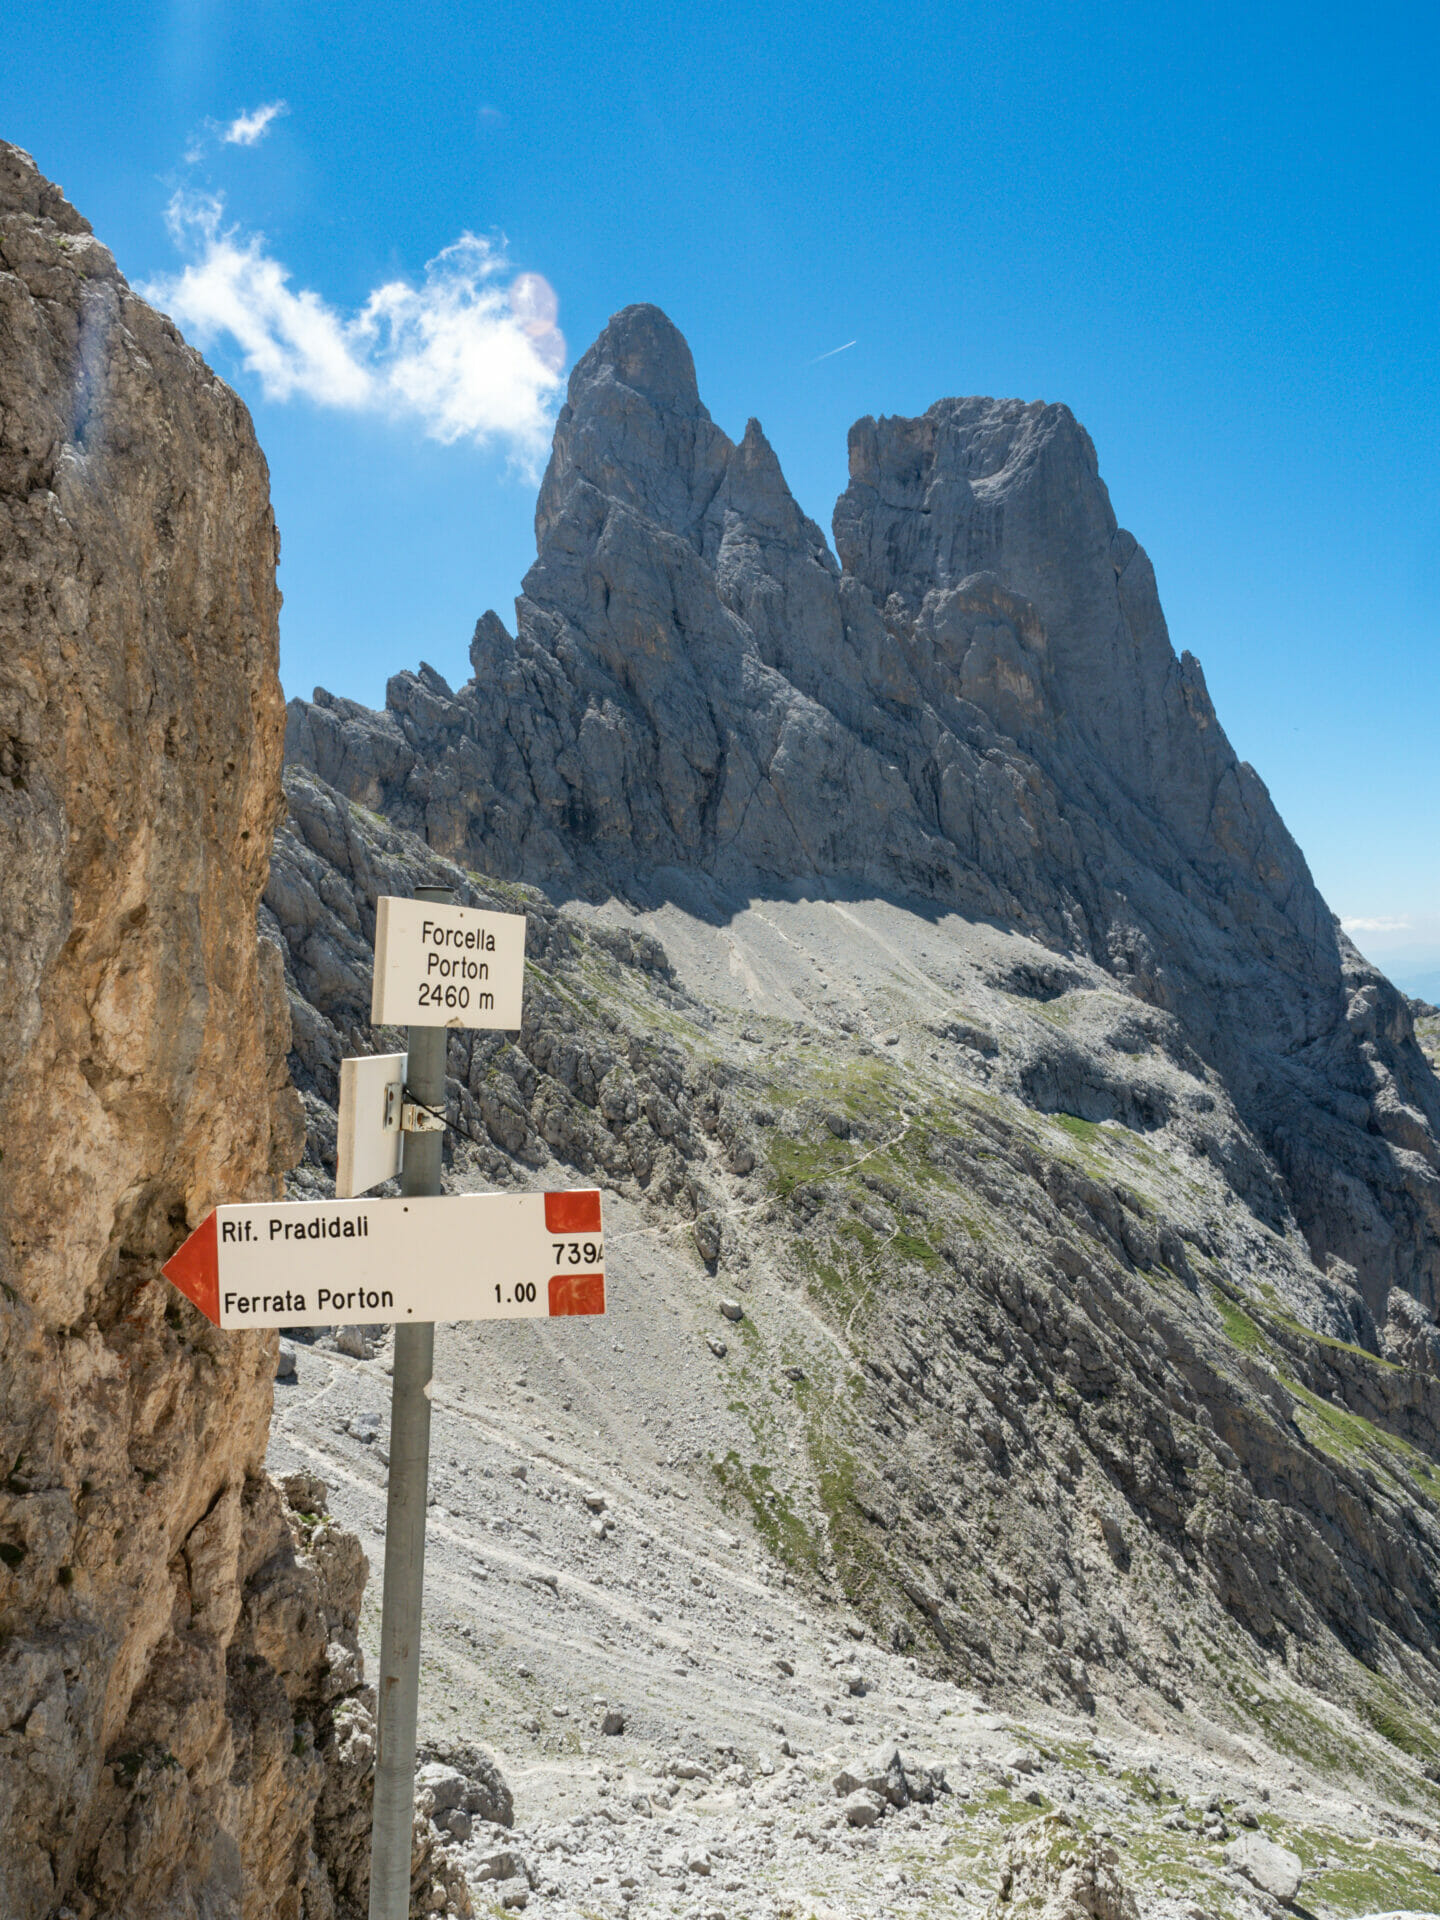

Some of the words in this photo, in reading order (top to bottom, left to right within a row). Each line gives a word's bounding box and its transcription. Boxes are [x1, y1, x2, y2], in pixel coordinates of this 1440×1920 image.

[422, 920, 496, 952] Forcella
[427, 952, 489, 980] Porton
[418, 982, 470, 1009] 2460
[479, 992, 494, 1010] m
[221, 1220, 259, 1243] Rif.
[269, 1215, 369, 1241] Pradidali
[224, 1289, 307, 1314] Ferrata
[317, 1286, 394, 1311] Porton
[494, 1281, 537, 1304] 1.00
